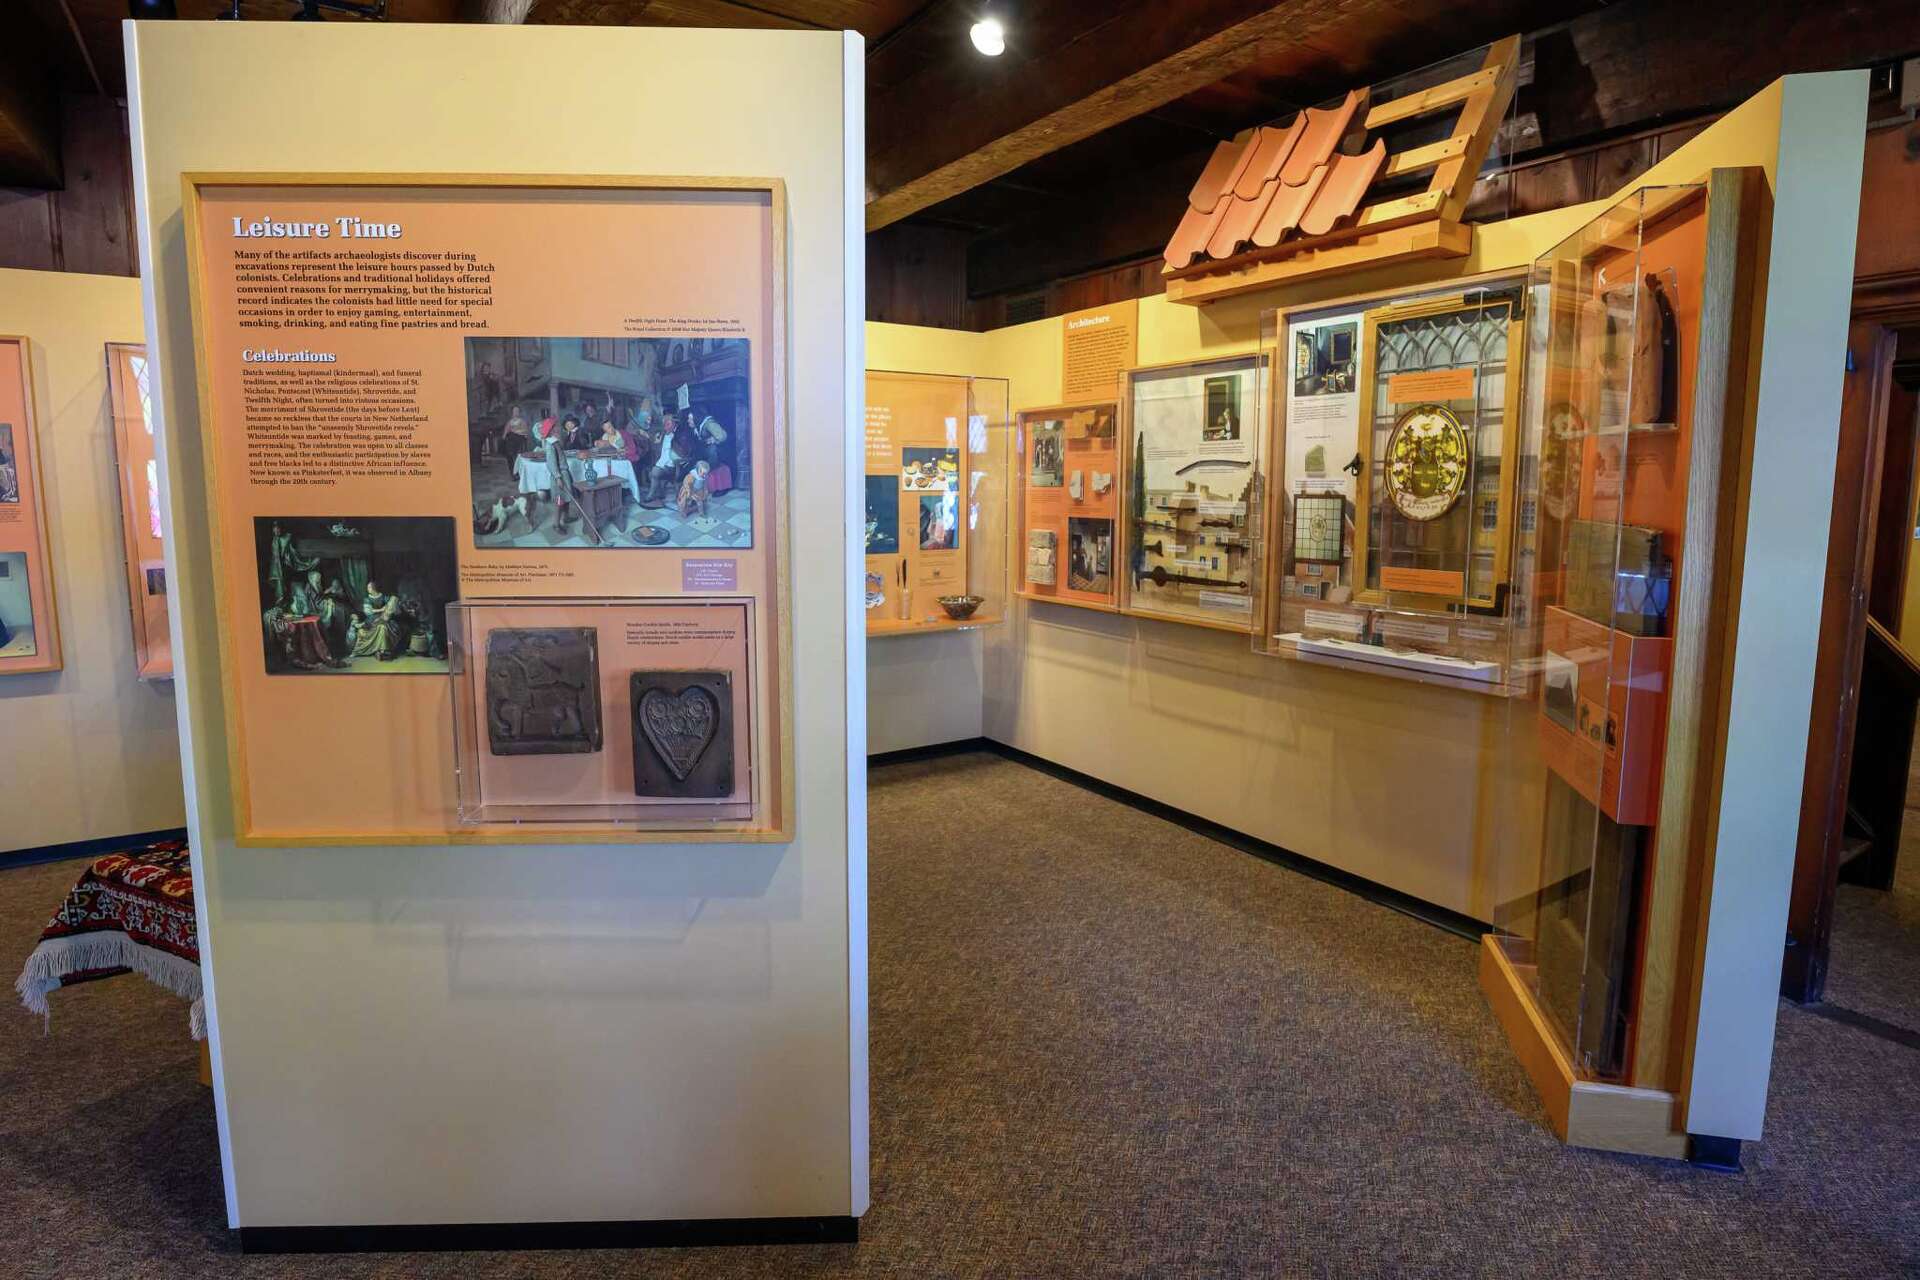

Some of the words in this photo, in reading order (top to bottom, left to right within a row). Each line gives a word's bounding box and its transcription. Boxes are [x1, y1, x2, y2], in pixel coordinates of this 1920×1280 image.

[232, 216, 330, 238] Leisure
[336, 216, 402, 238] Time
[234, 251, 261, 261] Many
[263, 251, 273, 259] of
[275, 251, 290, 259] the
[293, 251, 331, 259] artifacts
[334, 251, 401, 261] archaeologists
[403, 251, 442, 259] discover
[444, 251, 476, 262] during
[235, 262, 289, 270] excavations
[291, 264, 336, 273] represent
[356, 263, 388, 271] leisure
[391, 263, 417, 271] hours
[420, 263, 451, 273] passed
[454, 263, 465, 274] by
[467, 263, 495, 271] Dutch
[282, 273, 341, 281] Celebrations
[364, 274, 413, 282] traditional
[415, 274, 454, 284] holidays
[456, 274, 490, 282] offered
[237, 285, 288, 293] convenient
[329, 285, 342, 293] for
[344, 285, 410, 296] merrymaking,
[448, 286, 492, 294] historical
[238, 296, 268, 304] record
[271, 296, 313, 304] indicates
[315, 296, 330, 304] the
[376, 297, 393, 305] had
[396, 297, 417, 305] little
[420, 297, 442, 305] need
[445, 297, 458, 305] for
[460, 297, 493, 308] special
[337, 308, 361, 318] enjoy
[364, 308, 401, 318] gaming,
[403, 308, 472, 317] entertainment,
[239, 319, 282, 329] smoking,
[284, 319, 327, 330] drinking,
[329, 319, 347, 327] and
[349, 319, 378, 330] eating
[381, 319, 400, 327] fine
[401, 319, 438, 330] pastries
[1068, 315, 1111, 329] Architecture
[243, 349, 336, 362] Celebrations
[299, 369, 332, 377] baptismal
[327, 378, 357, 386] religious
[346, 406, 360, 414] (the
[361, 406, 376, 414] days
[402, 406, 420, 414] Lent)
[247, 424, 281, 432] attempted
[333, 433, 342, 441] by
[355, 451, 399, 459] participation
[400, 451, 409, 459] by
[408, 468, 432, 477] Albany
[250, 478, 278, 486] through
